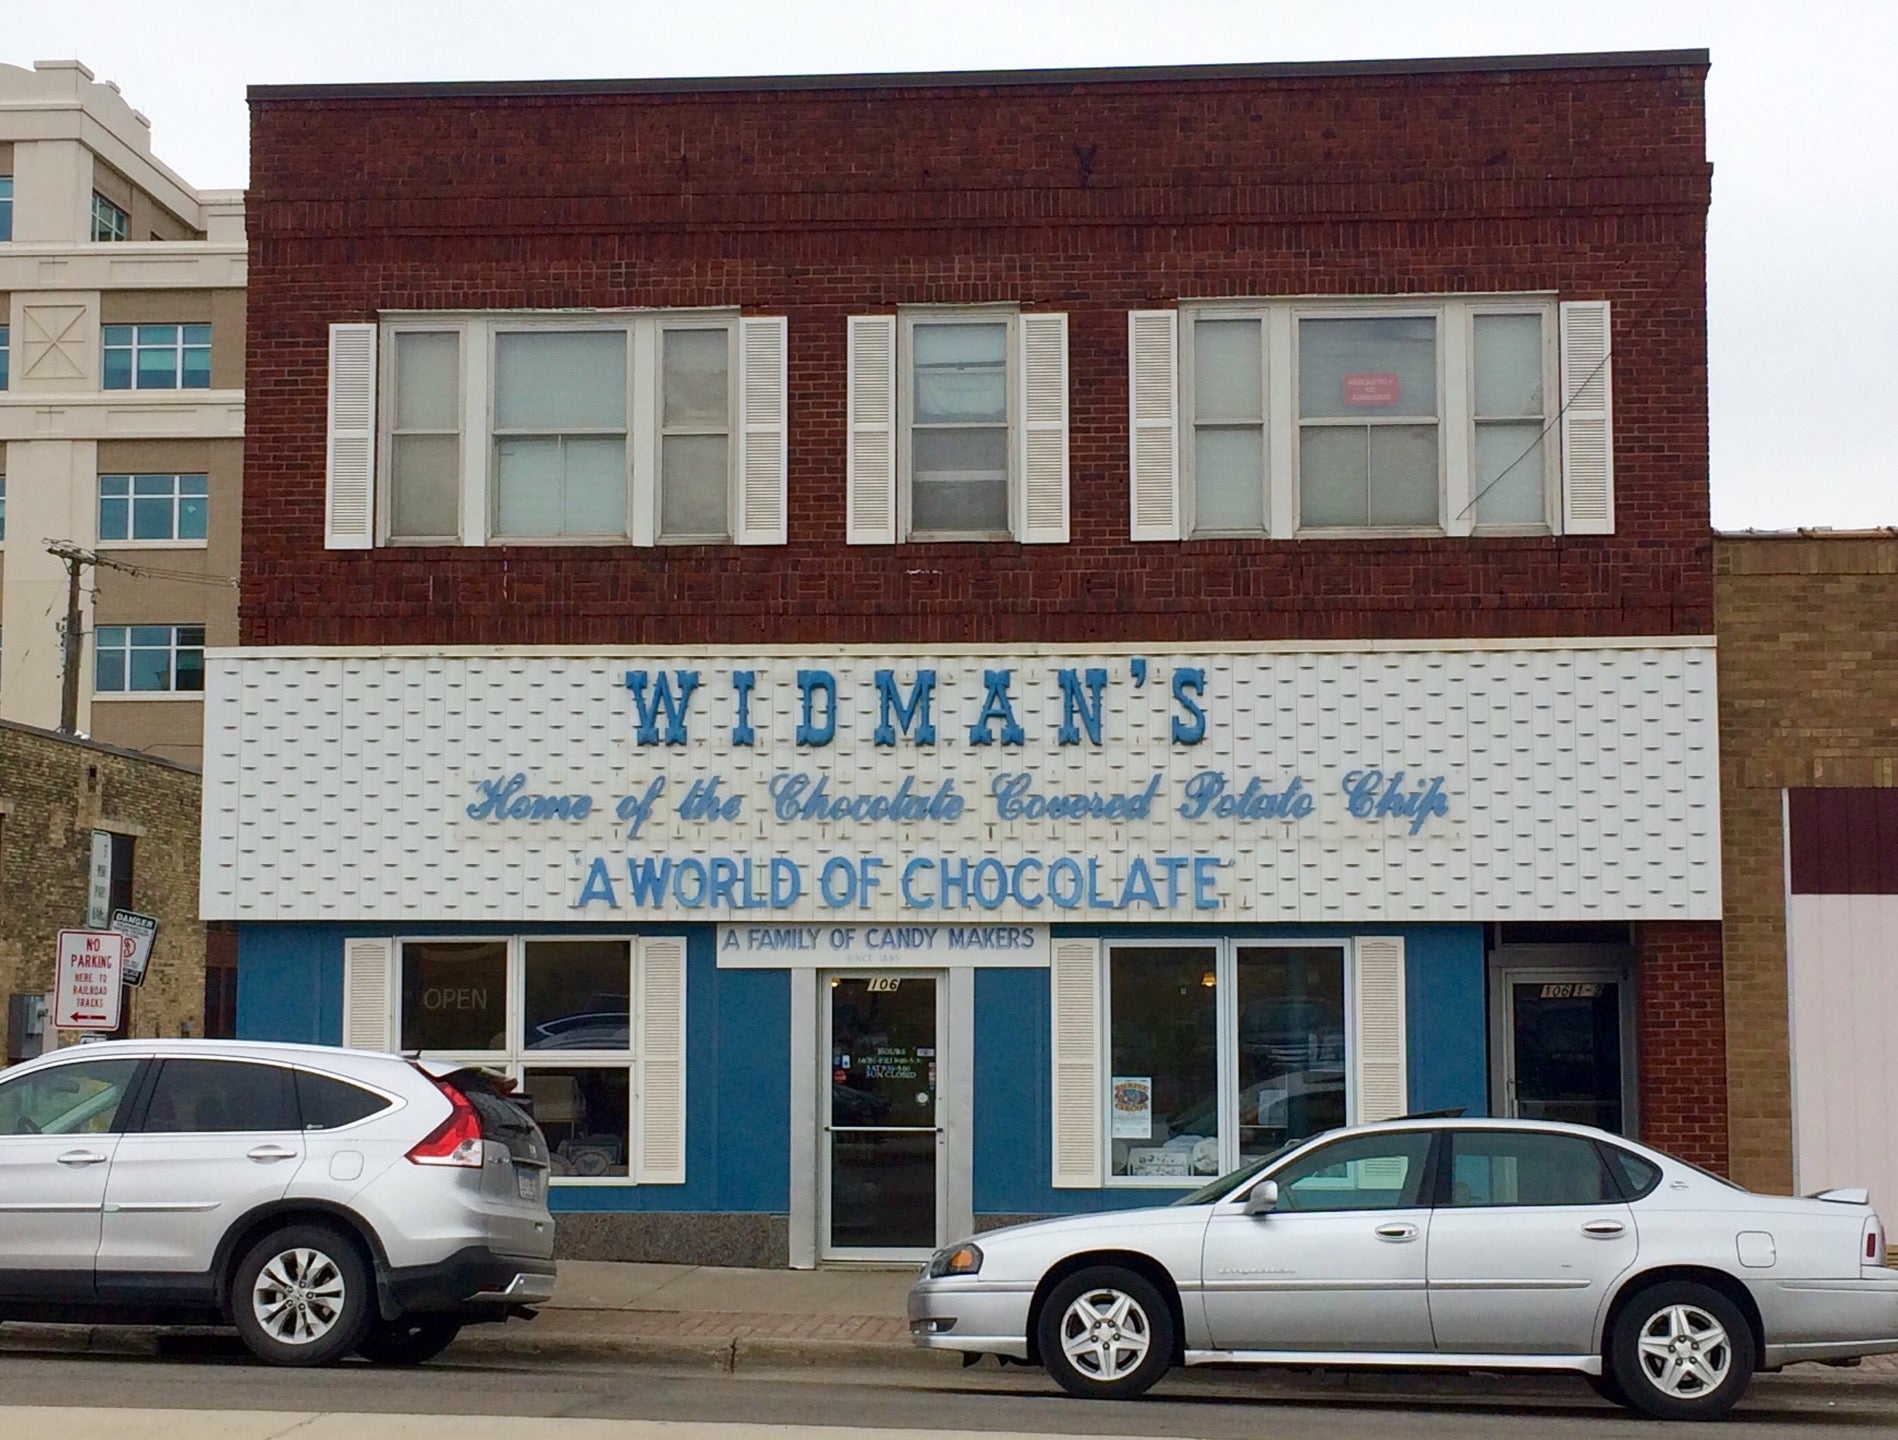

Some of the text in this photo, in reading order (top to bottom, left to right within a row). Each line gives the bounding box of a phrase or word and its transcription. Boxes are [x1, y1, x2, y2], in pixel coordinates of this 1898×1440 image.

[625, 658, 1206, 747] WIDMAN'S
[466, 770, 1449, 840] Home of the Chocolate Covered Potato Chip
[577, 856, 1221, 910] A WORLD OF CHOCOLATE
[115, 912, 155, 929] DANGER
[86, 937, 101, 952] NO
[722, 927, 1035, 950] A FAMILY OF CANDY MAKERS
[70, 954, 112, 969] PARKING
[847, 953, 873, 963] SINCE
[74, 972, 107, 983] HERE TO
[872, 979, 899, 990] 106
[72, 984, 108, 995] RAILROAD
[1545, 985, 1570, 997] 106
[76, 998, 103, 1008] TRACKS
[424, 988, 487, 1010] OPEN
